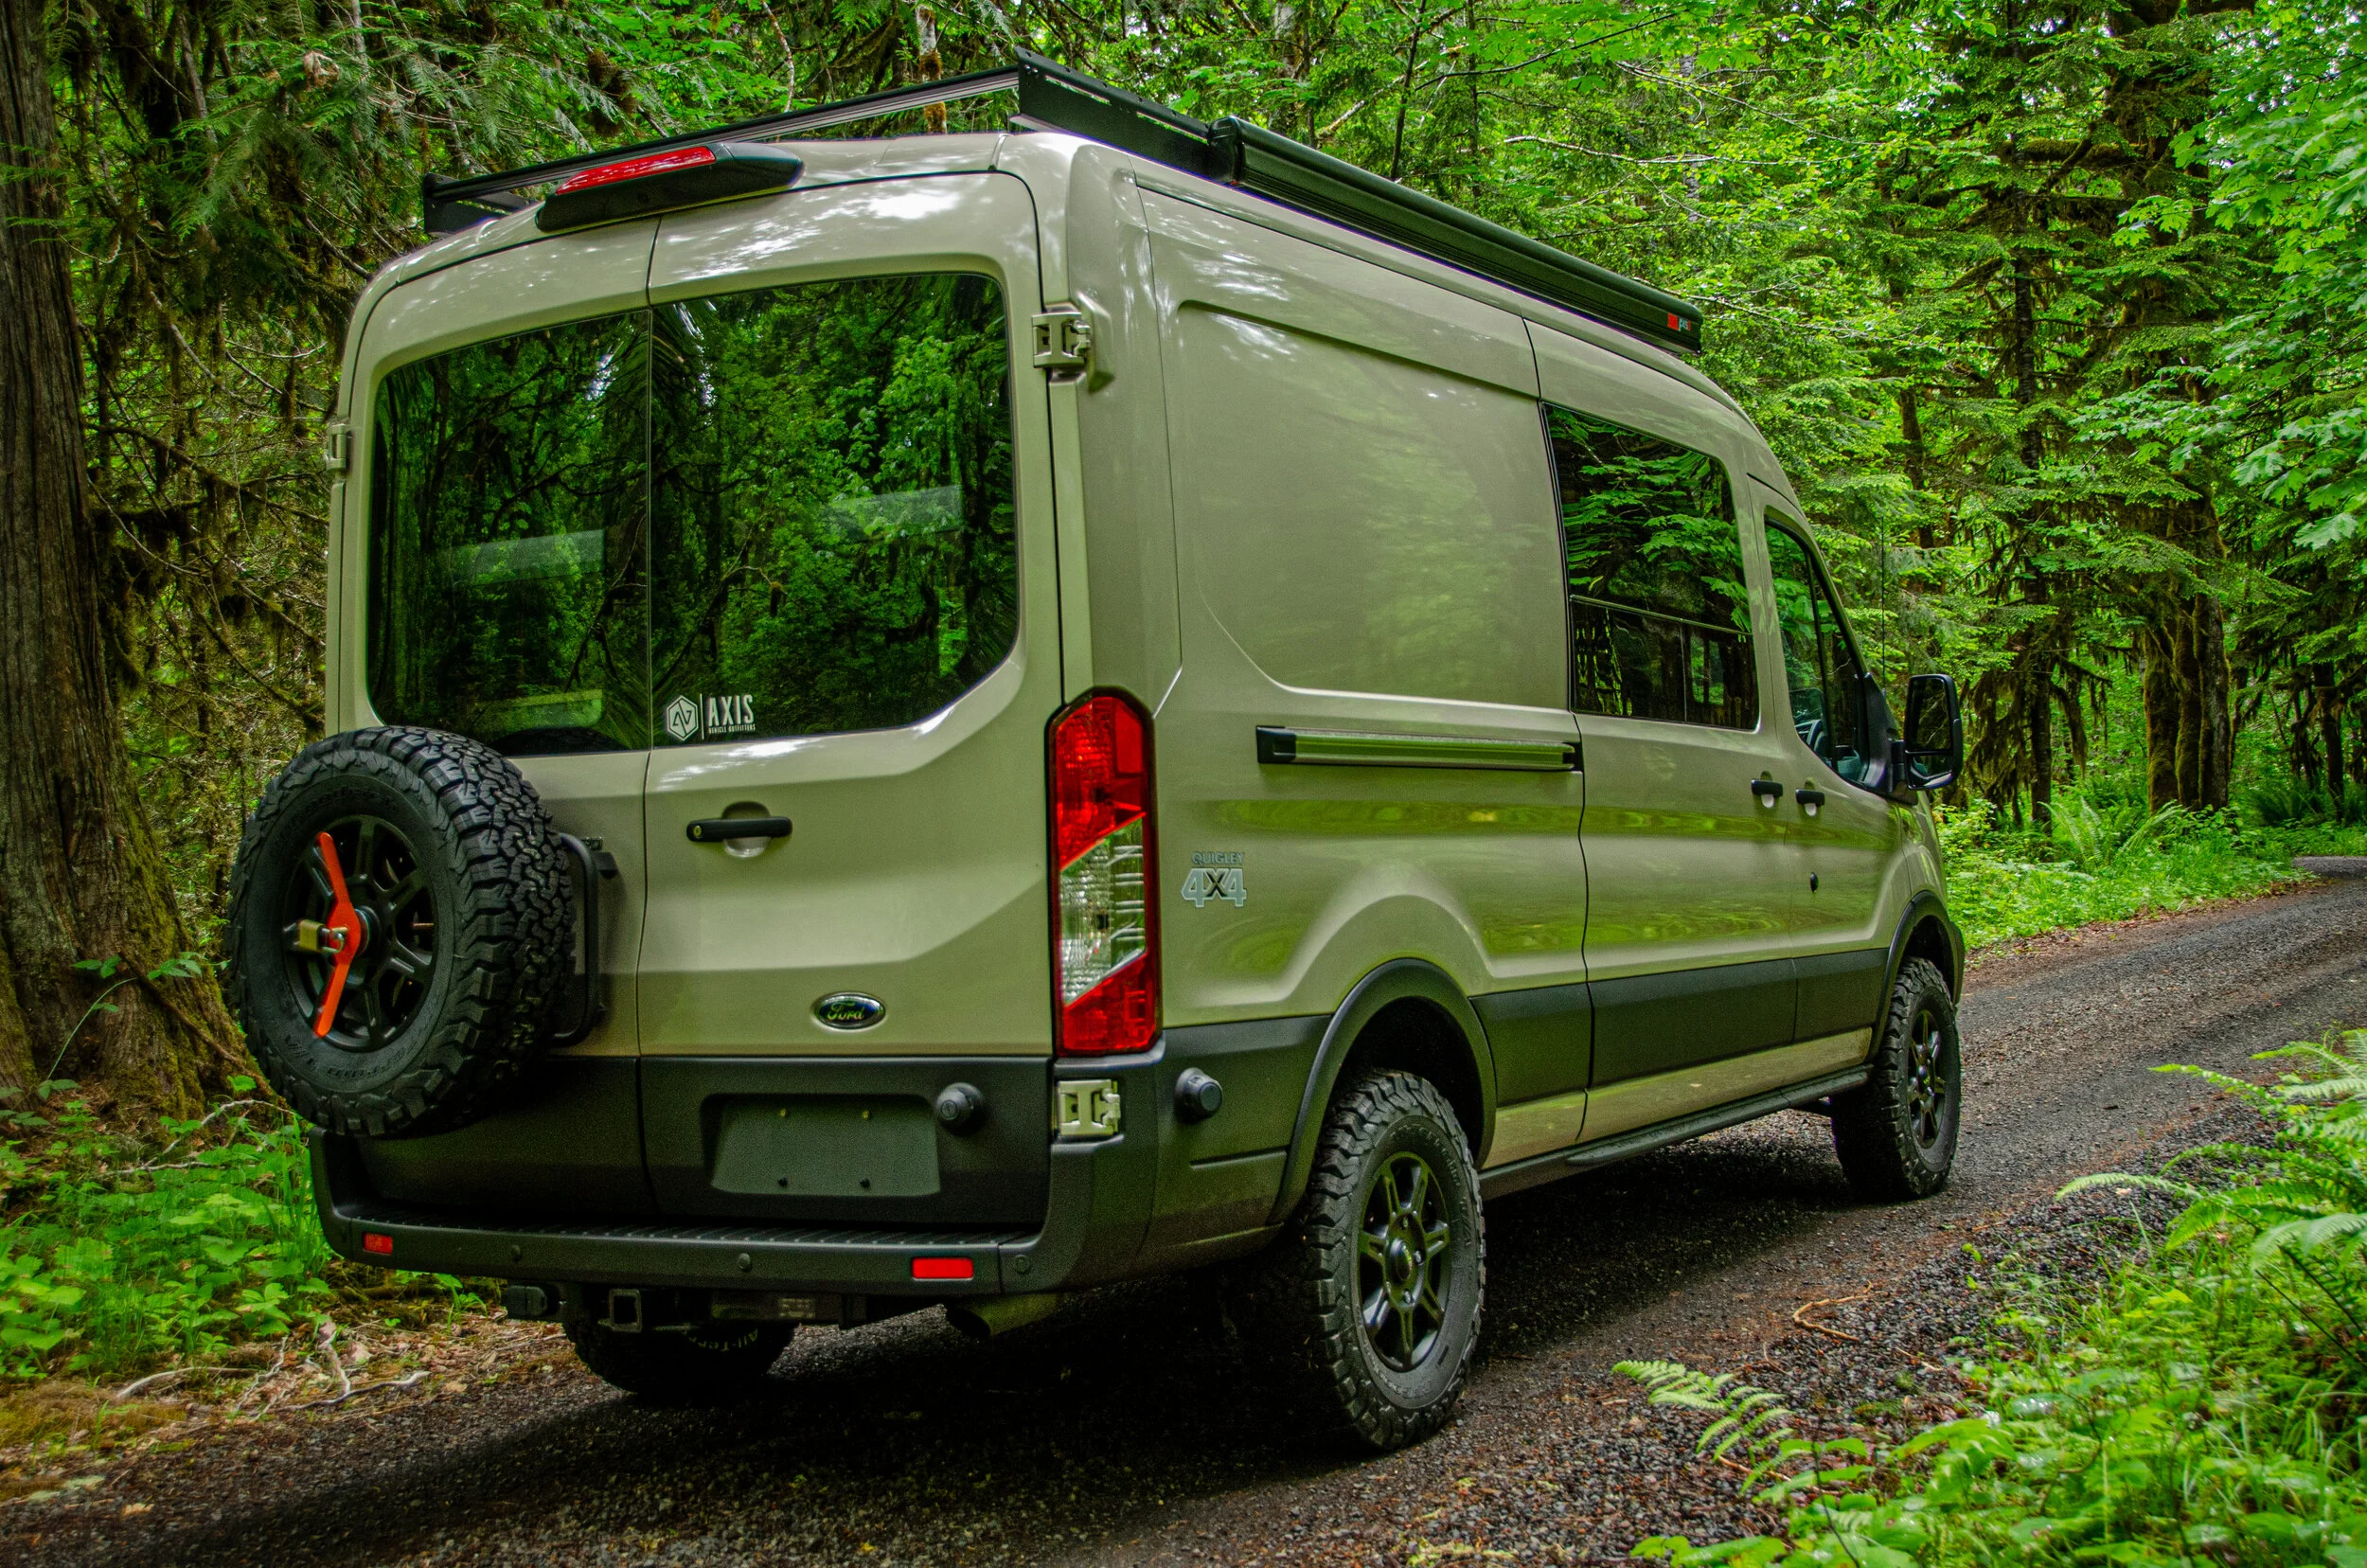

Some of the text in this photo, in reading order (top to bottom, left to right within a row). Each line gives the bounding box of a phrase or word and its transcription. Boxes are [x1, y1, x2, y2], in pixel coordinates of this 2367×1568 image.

[708, 694, 755, 727] AXIS
[1192, 851, 1244, 866] QUIGLEY
[826, 1001, 866, 1021] Ford
